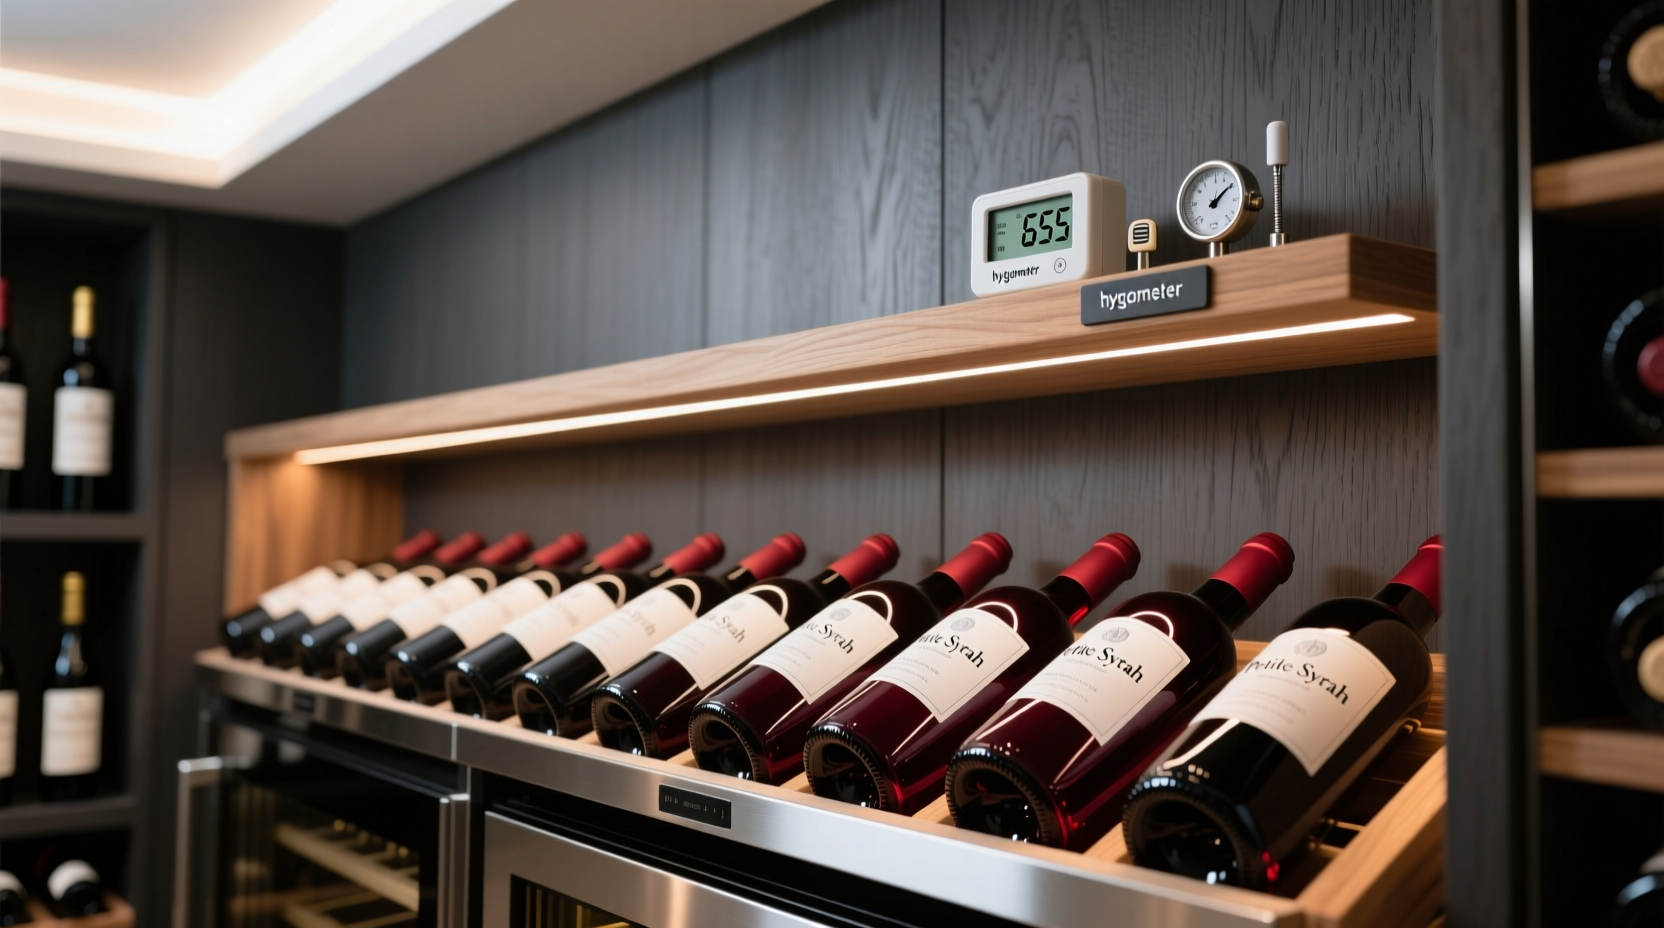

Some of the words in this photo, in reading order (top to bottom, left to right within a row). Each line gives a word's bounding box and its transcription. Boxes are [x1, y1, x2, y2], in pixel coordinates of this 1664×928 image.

[1021, 206, 1070, 248] 655
[1100, 282, 1183, 311] hygometer
[944, 634, 984, 669] Syrah
[1097, 646, 1144, 684] Syrah
[1296, 662, 1349, 705] Syrah
